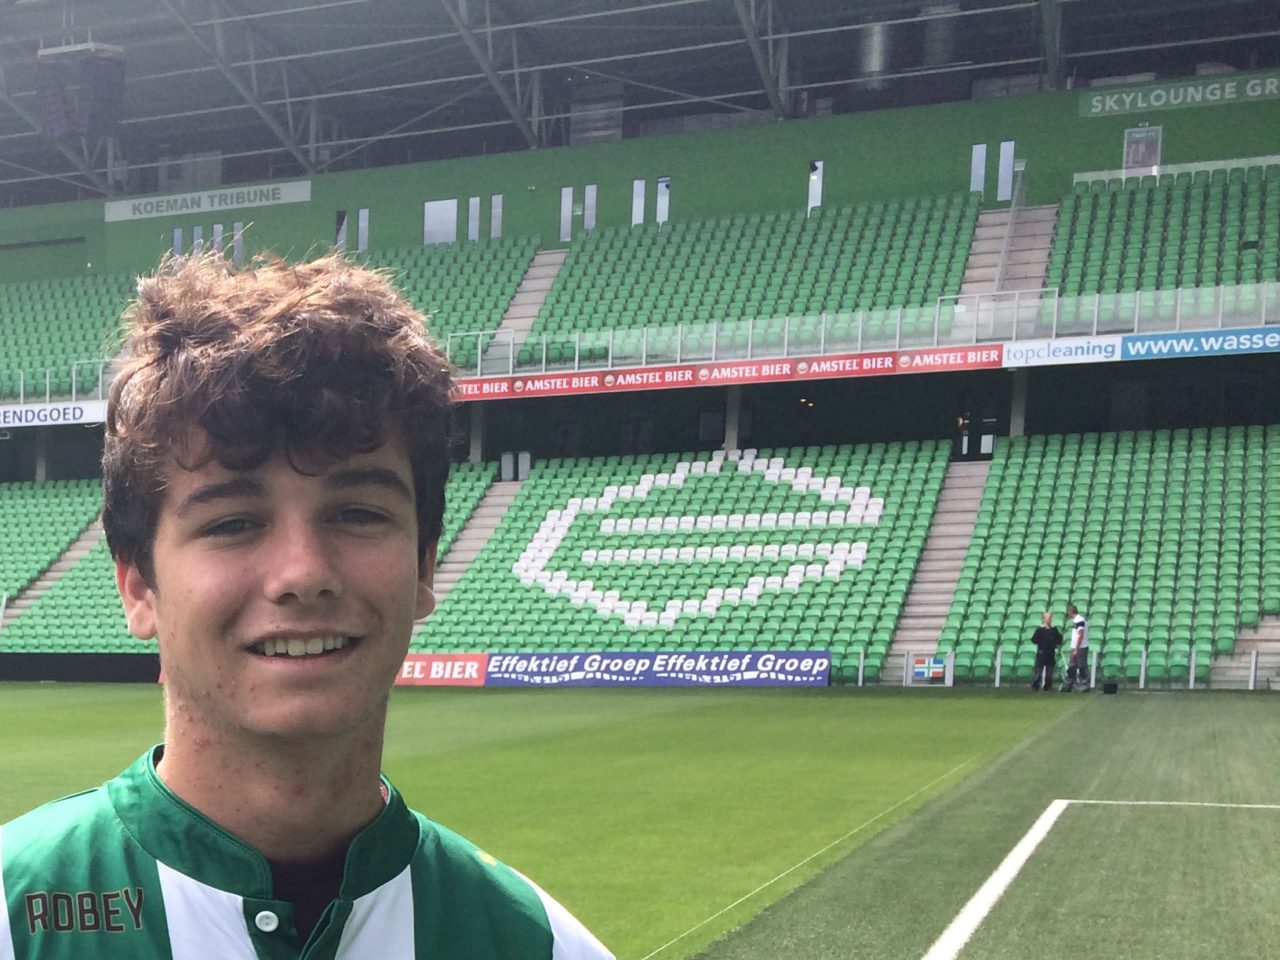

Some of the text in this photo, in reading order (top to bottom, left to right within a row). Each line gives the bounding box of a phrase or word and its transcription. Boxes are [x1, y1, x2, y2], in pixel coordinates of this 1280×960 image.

[1090, 78, 1279, 113] SKYLOUNGE GR
[131, 187, 282, 215] KOEMAN TRIBUNE
[1006, 341, 1116, 366] topcleaning
[1127, 333, 1280, 356] www.wasse
[810, 356, 894, 373] AMSTEL BIER
[912, 350, 1000, 367] AMSTEL BIER
[616, 370, 693, 385] AMSTEL BIER
[711, 363, 791, 379] AMSTEL BIER
[482, 382, 509, 394] BIER
[525, 376, 599, 391] AMSTEL BIER
[430, 660, 479, 680] BIER
[487, 654, 650, 675] Effektief Groep
[652, 654, 829, 675] Effektief Groep
[25, 887, 145, 935] ROBEY
